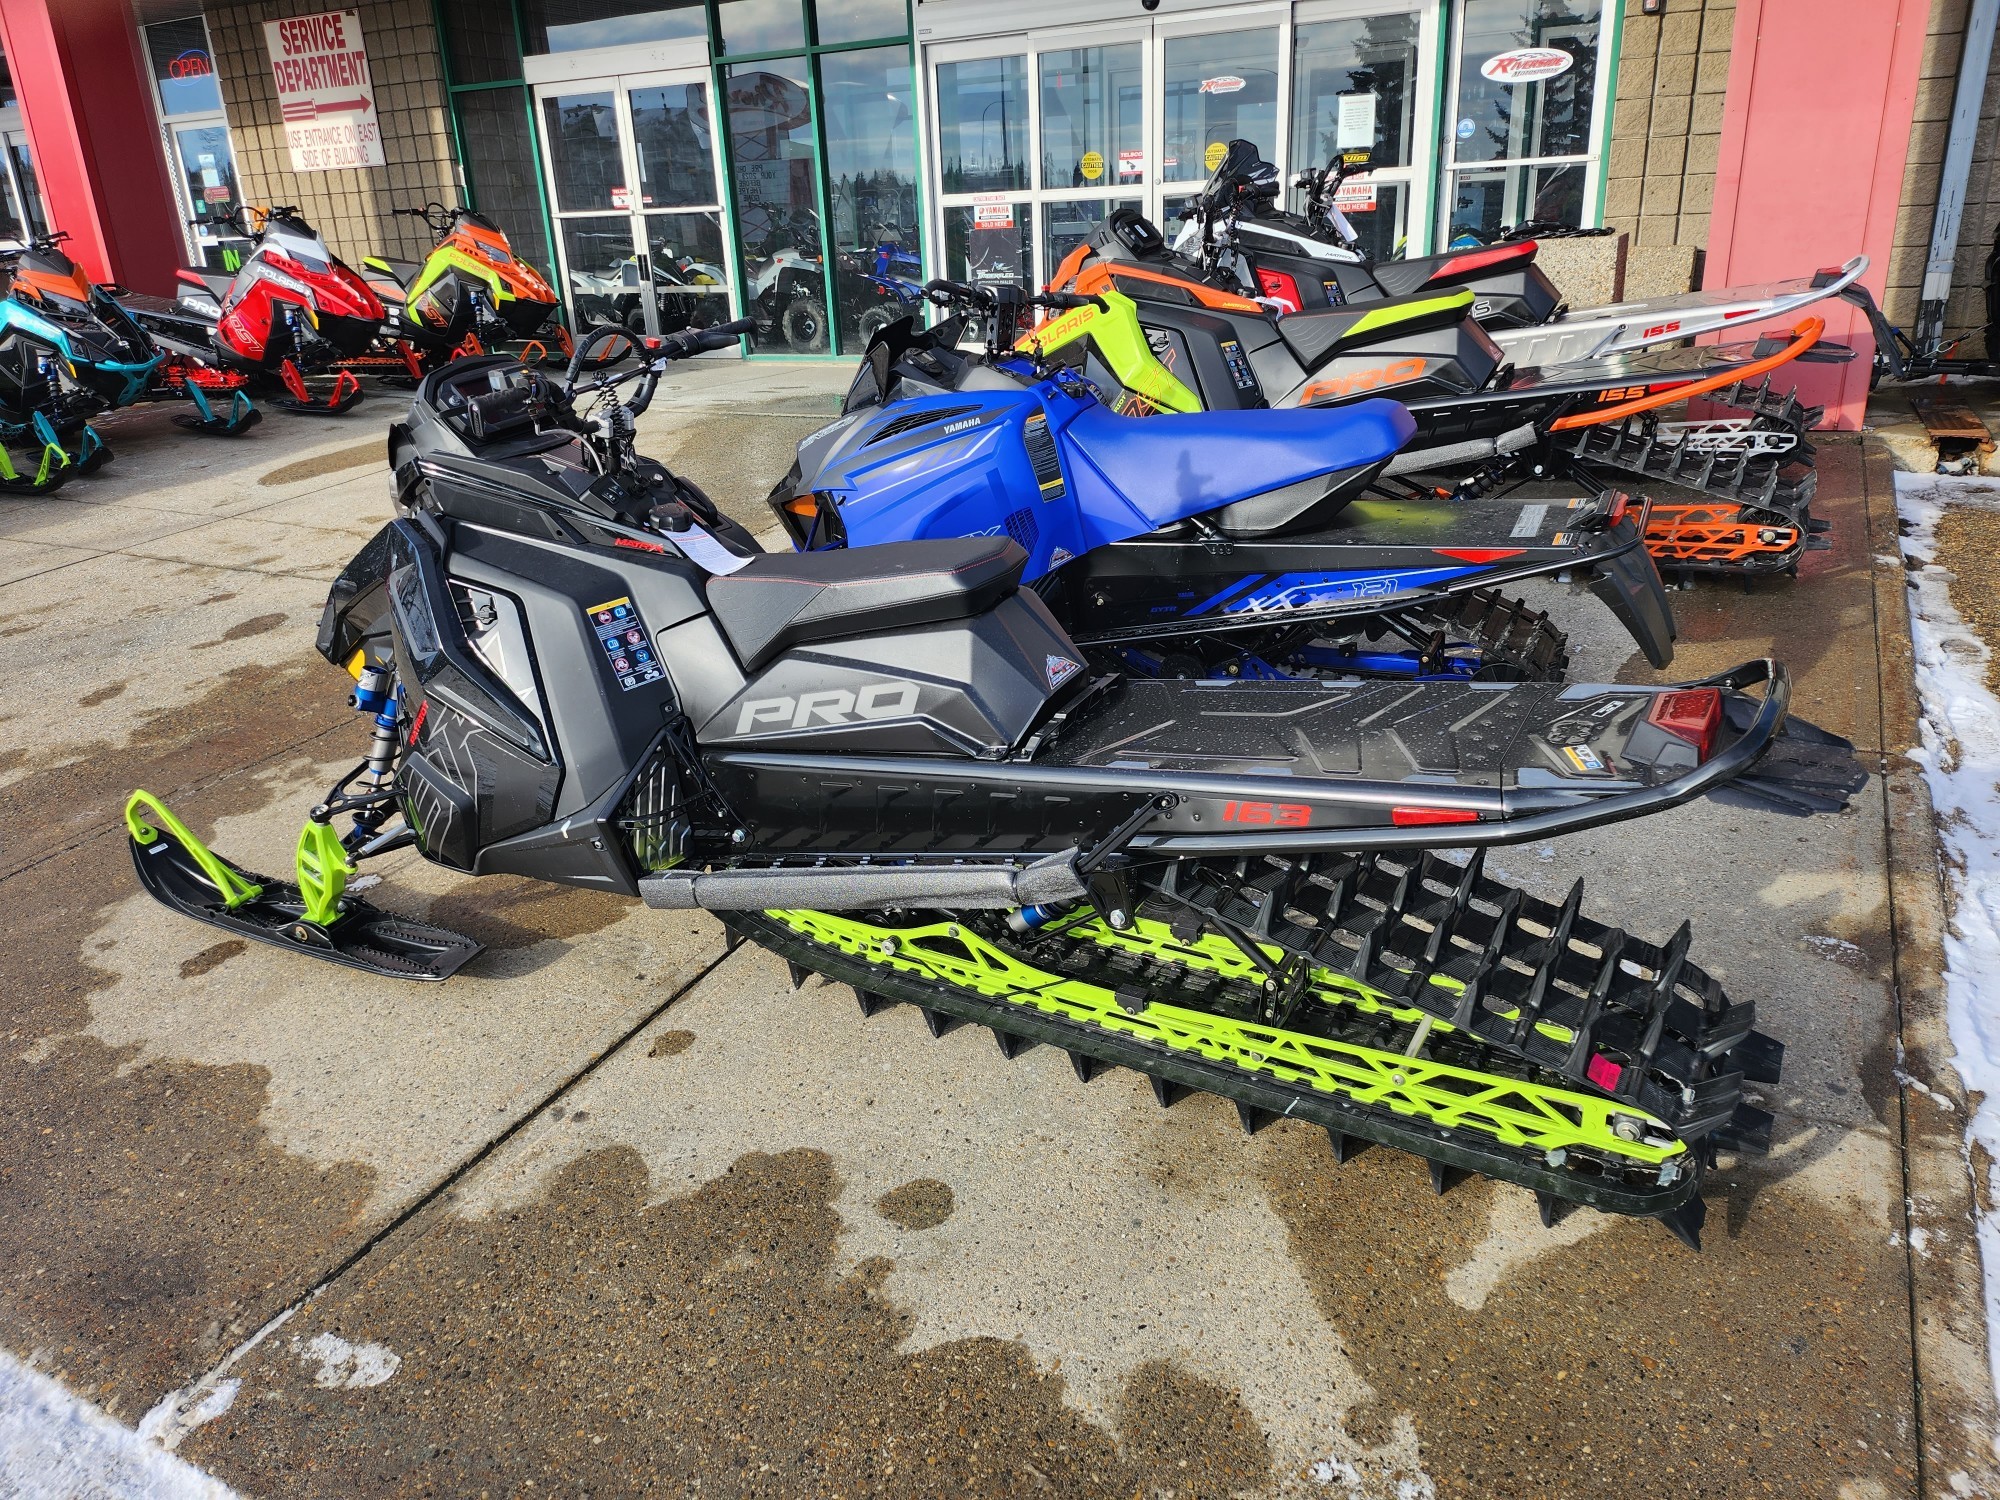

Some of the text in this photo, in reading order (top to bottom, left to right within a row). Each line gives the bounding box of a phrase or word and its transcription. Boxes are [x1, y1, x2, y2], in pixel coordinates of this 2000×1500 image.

[279, 14, 346, 56] SERVICE
[169, 58, 211, 80] OPEN
[273, 51, 367, 94] DEPARTMENT
[1487, 56, 1566, 76] RIVERSIDE
[287, 122, 377, 149] USE ENTRANCE ON EAST
[302, 145, 370, 168] SIDE OF BUILDING
[1341, 186, 1373, 195] YAMAHA
[985, 206, 1010, 215] YAMAHA
[1351, 202, 1368, 210] HERE
[222, 249, 241, 272] IN
[449, 252, 490, 277] POLARIS
[256, 265, 304, 293] POLARIS
[182, 296, 222, 318] PRO
[1642, 320, 1681, 339] 155
[1298, 357, 1428, 406] PRO
[1597, 385, 1646, 403] 155
[943, 417, 981, 435] YAMAHA
[1352, 578, 1399, 598] 121
[735, 681, 921, 735] PRO
[1222, 800, 1313, 827] 163
